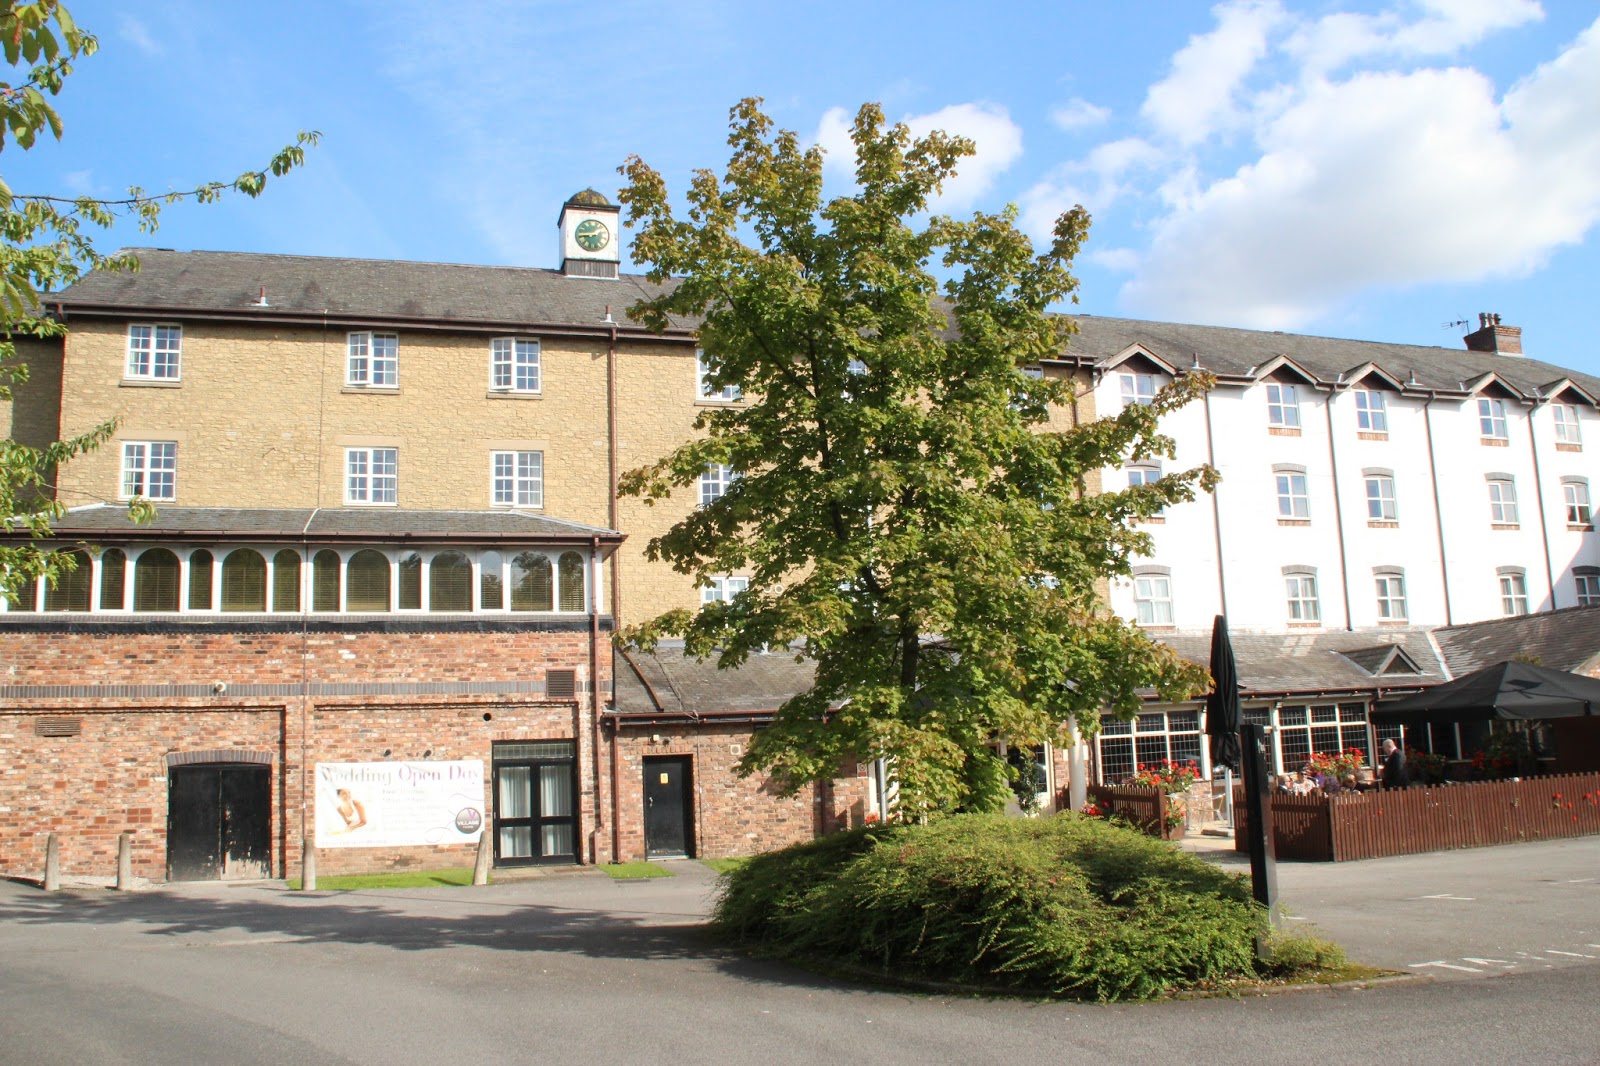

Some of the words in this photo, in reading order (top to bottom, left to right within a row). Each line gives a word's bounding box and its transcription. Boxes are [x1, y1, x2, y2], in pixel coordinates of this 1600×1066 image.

[320, 764, 392, 785] Wedding
[398, 764, 441, 786] Open
[449, 764, 479, 785] Day
